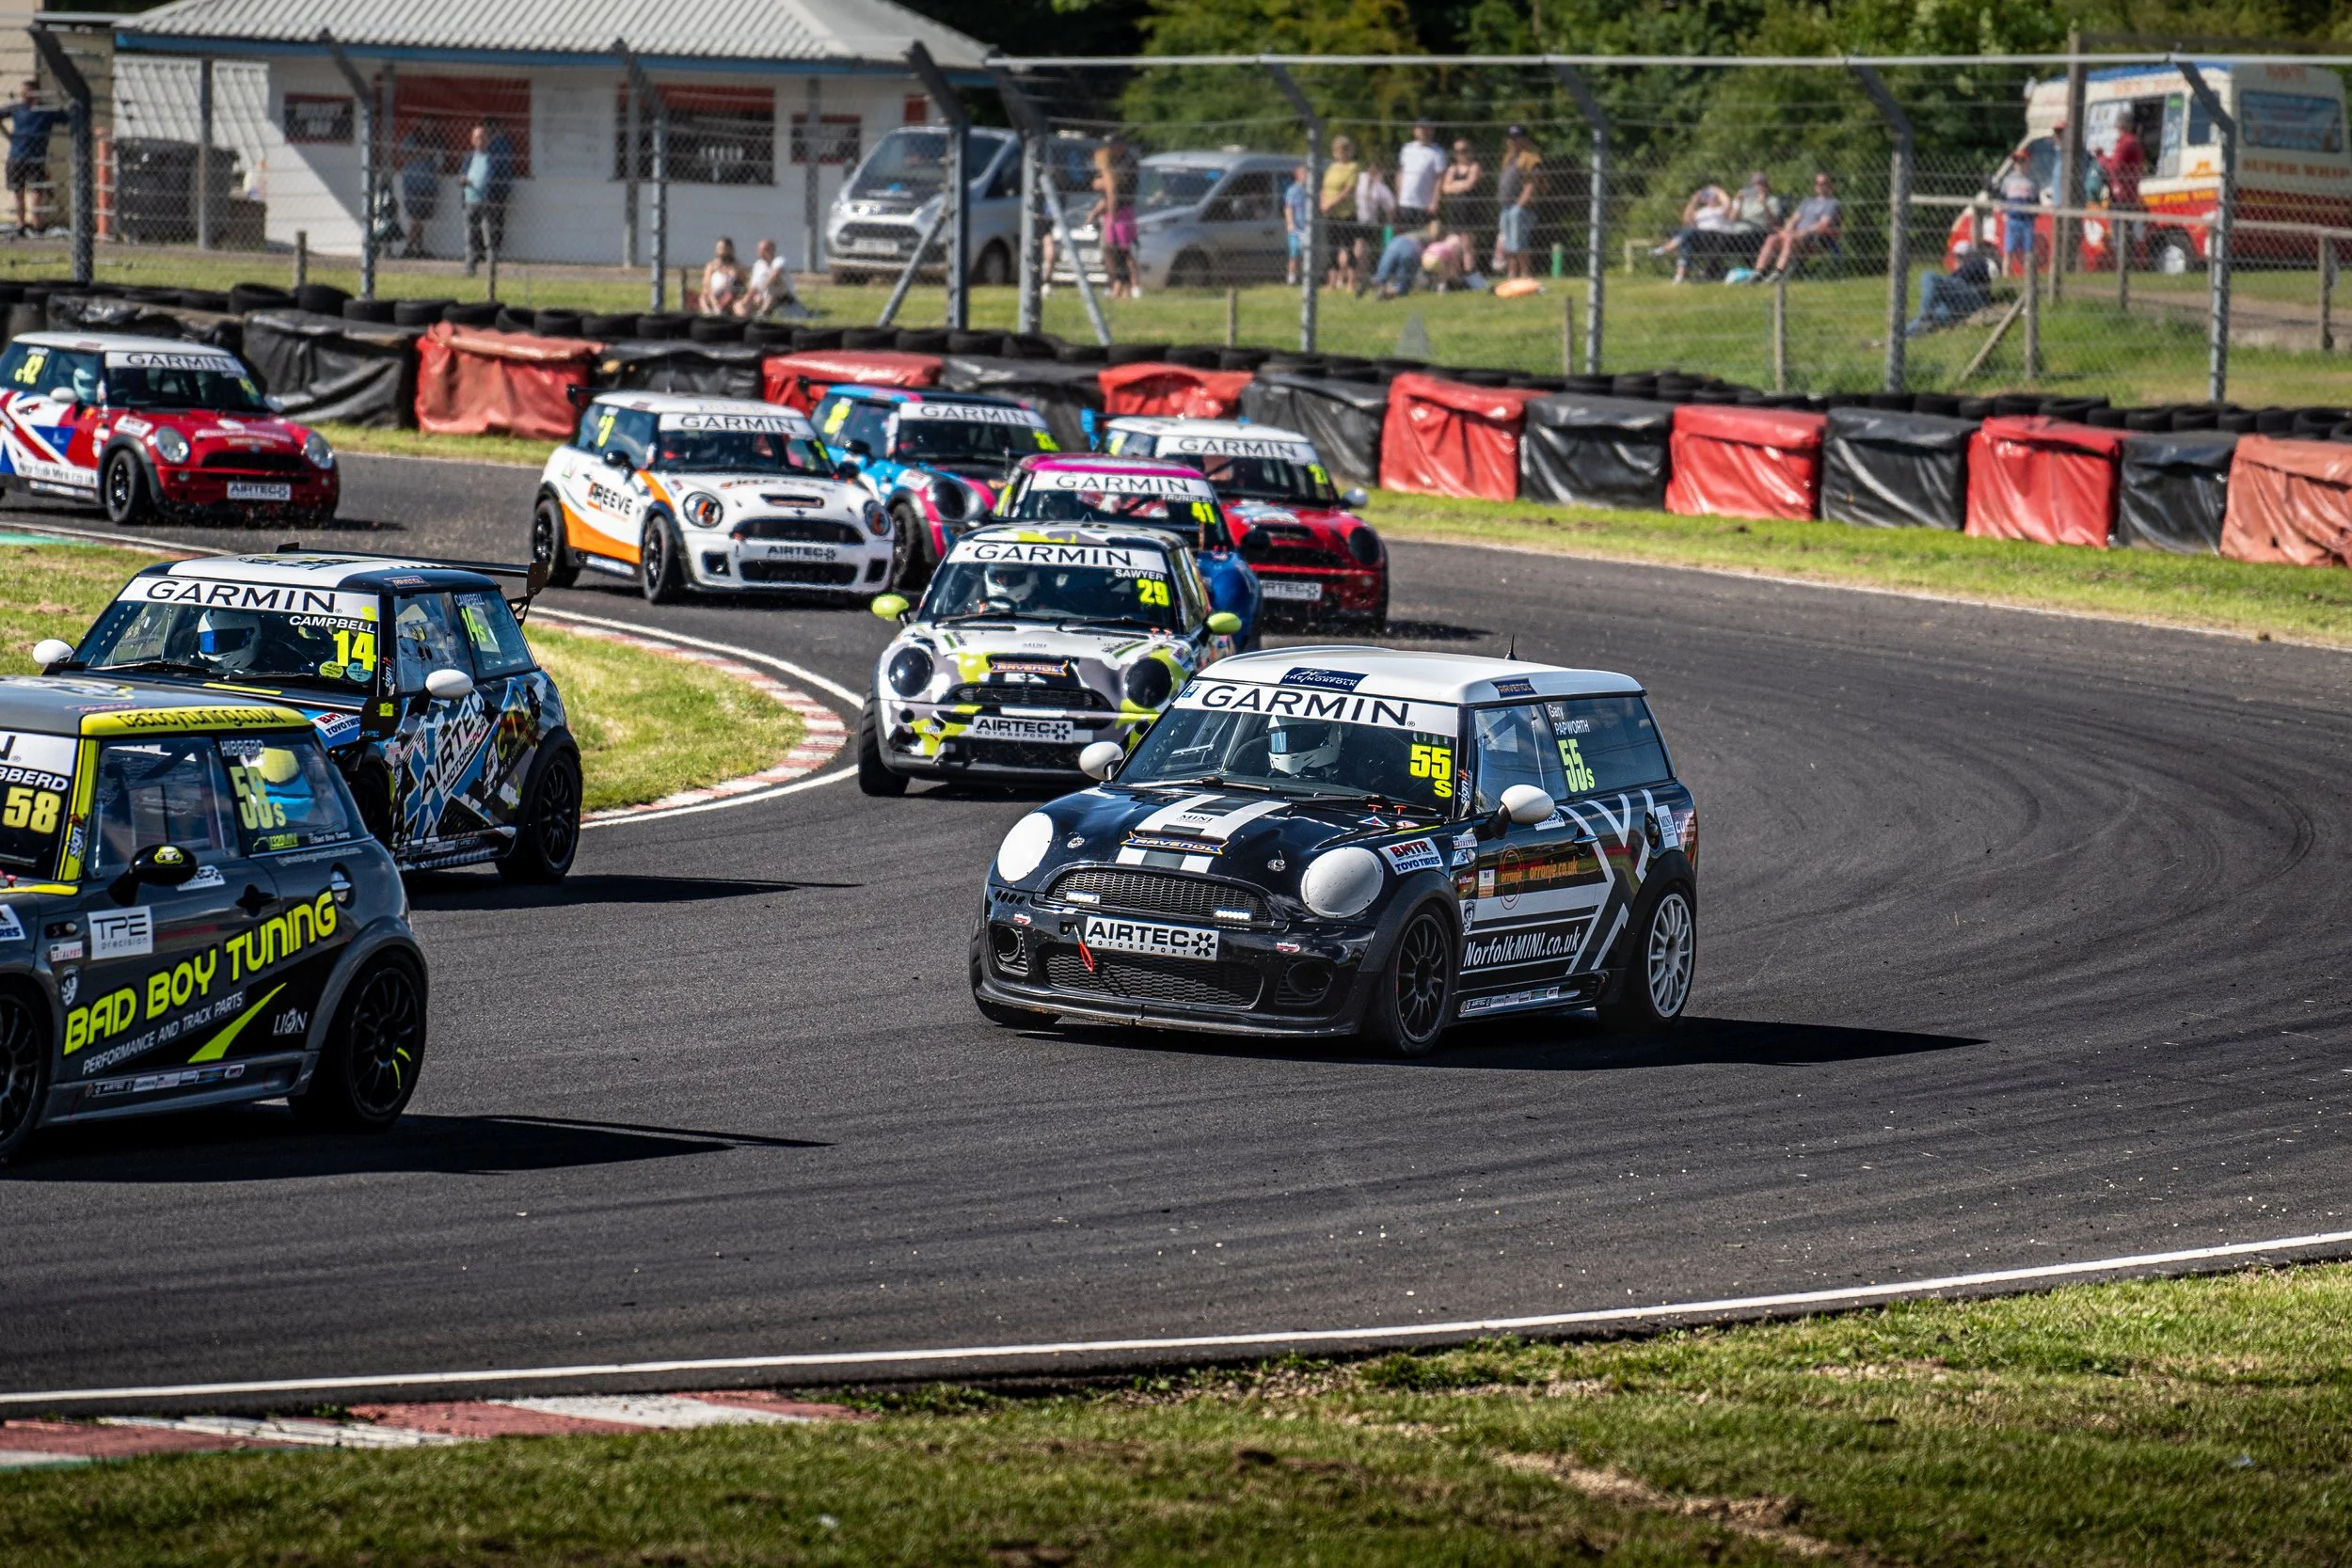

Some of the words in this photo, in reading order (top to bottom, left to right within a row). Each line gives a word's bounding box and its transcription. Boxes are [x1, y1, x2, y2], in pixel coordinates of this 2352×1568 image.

[126, 353, 232, 371] GARMIN
[920, 404, 1031, 423] GARMIN
[680, 415, 797, 433] GARMIN
[1178, 438, 1298, 458] GARMIN
[1056, 474, 1190, 494] GARMIN
[767, 546, 824, 558] AIRTEC
[974, 543, 1133, 566] GARMIN
[1115, 568, 1165, 581] SAWYER
[146, 579, 337, 613] GARMIN
[1136, 578, 1170, 607] 29
[1263, 582, 1307, 593] RTEC
[453, 593, 485, 607] CAMPBELL
[289, 615, 376, 635] CAMPBELL
[333, 629, 376, 672] 14
[1201, 685, 1409, 726] GARMIN
[1548, 704, 1565, 720] Gary
[326, 721, 347, 736] TOYO
[346, 715, 363, 729] TIRE
[976, 718, 1053, 734] AIRTEC
[976, 730, 1051, 738] MOTORSPORT
[1554, 719, 1591, 736] PAPWORTH
[219, 739, 265, 757] HIBBERD
[442, 719, 488, 792] MOTORSPOR
[1409, 743, 1452, 781] 55
[2, 785, 62, 835] 58
[1181, 814, 1214, 822] MINI
[1134, 838, 1216, 852] RAVENOL
[1389, 840, 1432, 859] BMTR
[1394, 858, 1420, 872] TOYO
[1420, 855, 1440, 866] TIRES
[0, 926, 21, 938] RES
[92, 913, 148, 941] TPE
[1087, 920, 1190, 948] AIRTEC
[101, 936, 148, 951] precision
[1086, 939, 1189, 956] MOTORSPORT
[1462, 925, 1581, 968] NorfolkMINI.co.uk
[63, 987, 137, 1056] BAD
[145, 947, 217, 1021] BOY
[225, 890, 338, 983] TUNING
[82, 1031, 156, 1077] PERFORMANCE
[157, 1021, 180, 1043] AND
[183, 1006, 213, 1033] TRACK
[214, 990, 244, 1019] PARTS
